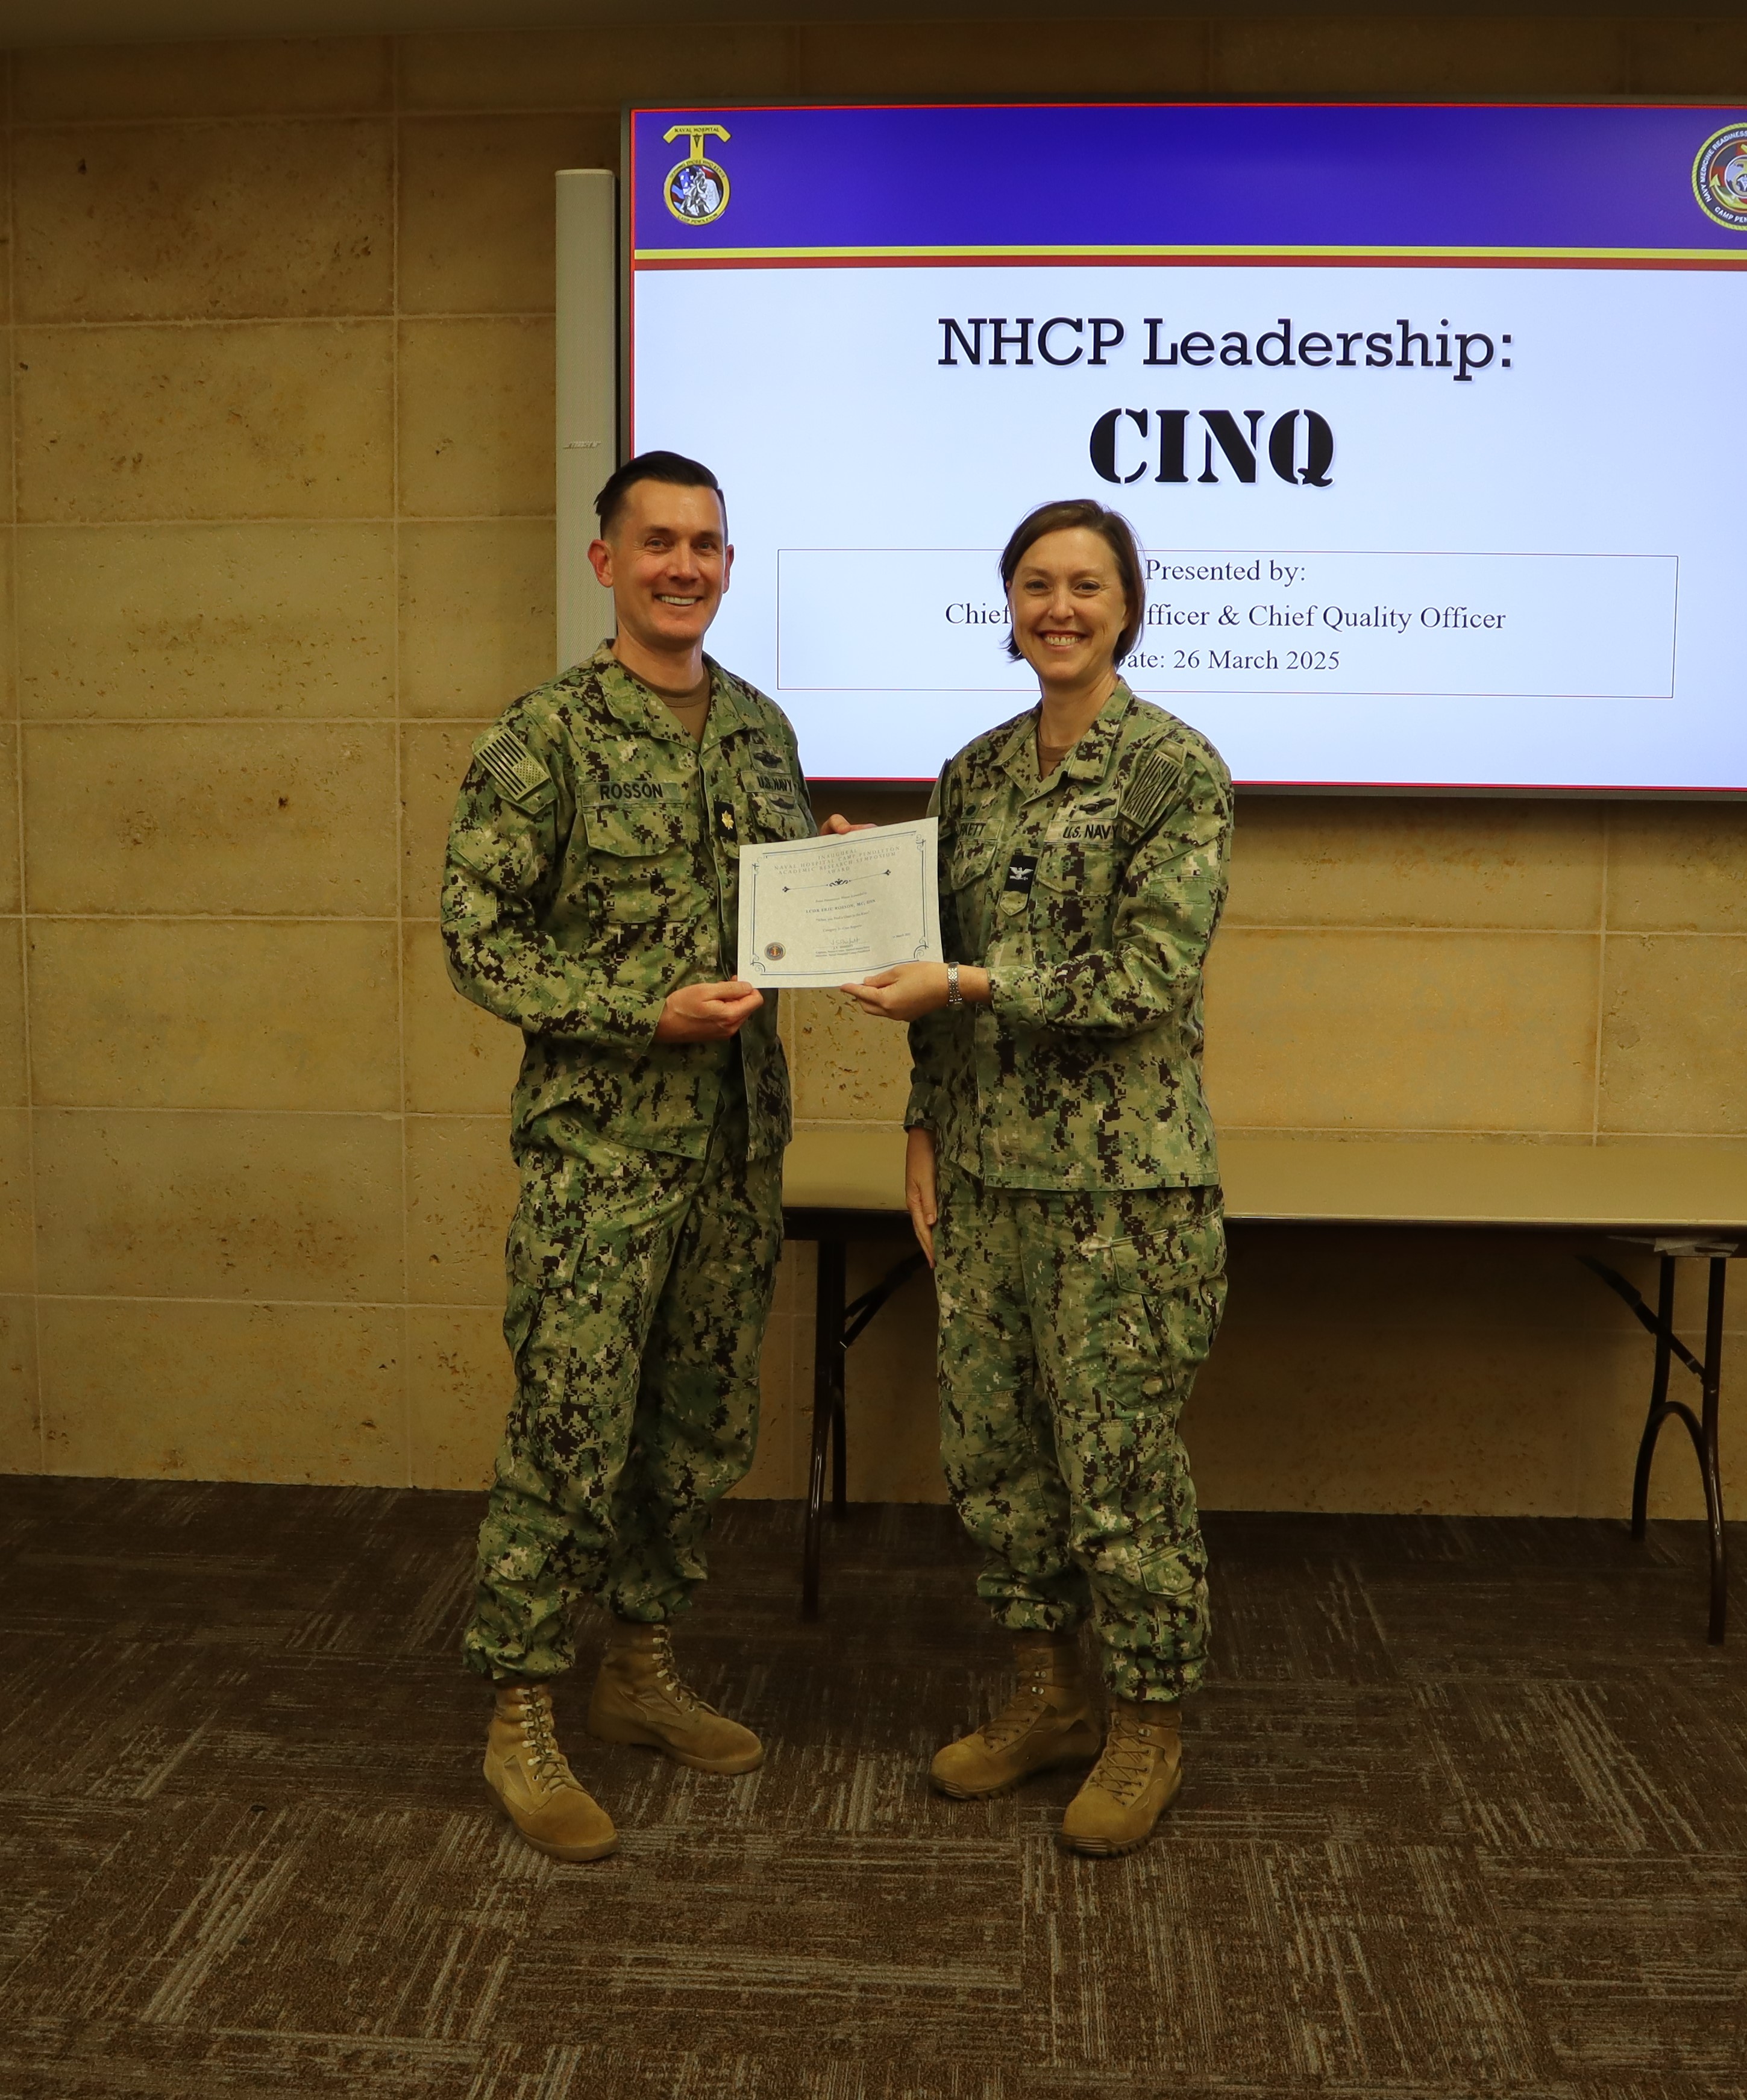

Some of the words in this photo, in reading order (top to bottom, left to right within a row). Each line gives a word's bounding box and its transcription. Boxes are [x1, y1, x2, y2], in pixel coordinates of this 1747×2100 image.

[1699, 148, 1715, 183] MEDICINE
[1700, 184, 1713, 203] NAVY
[1714, 206, 1734, 220] CAMP
[938, 317, 1124, 366] NHCP
[1143, 318, 1512, 382] Leadership:
[1089, 407, 1335, 487] CINQ
[1145, 559, 1261, 581] Presented
[1269, 559, 1305, 588] by:
[946, 603, 1011, 624] Chief
[1146, 603, 1210, 625] fficer
[1218, 605, 1240, 625] &
[1249, 604, 1319, 627] Chief
[1323, 606, 1413, 634] Quality
[1420, 606, 1507, 629] Officer
[1119, 651, 1164, 668] ate:
[1173, 650, 1200, 669] 26
[1208, 650, 1279, 669] March
[1286, 651, 1340, 670] 2025
[600, 783, 663, 800] ROSSON
[772, 777, 792, 792] NAVY
[1062, 826, 1082, 838] U.S.
[1085, 824, 1119, 839] NAVY
